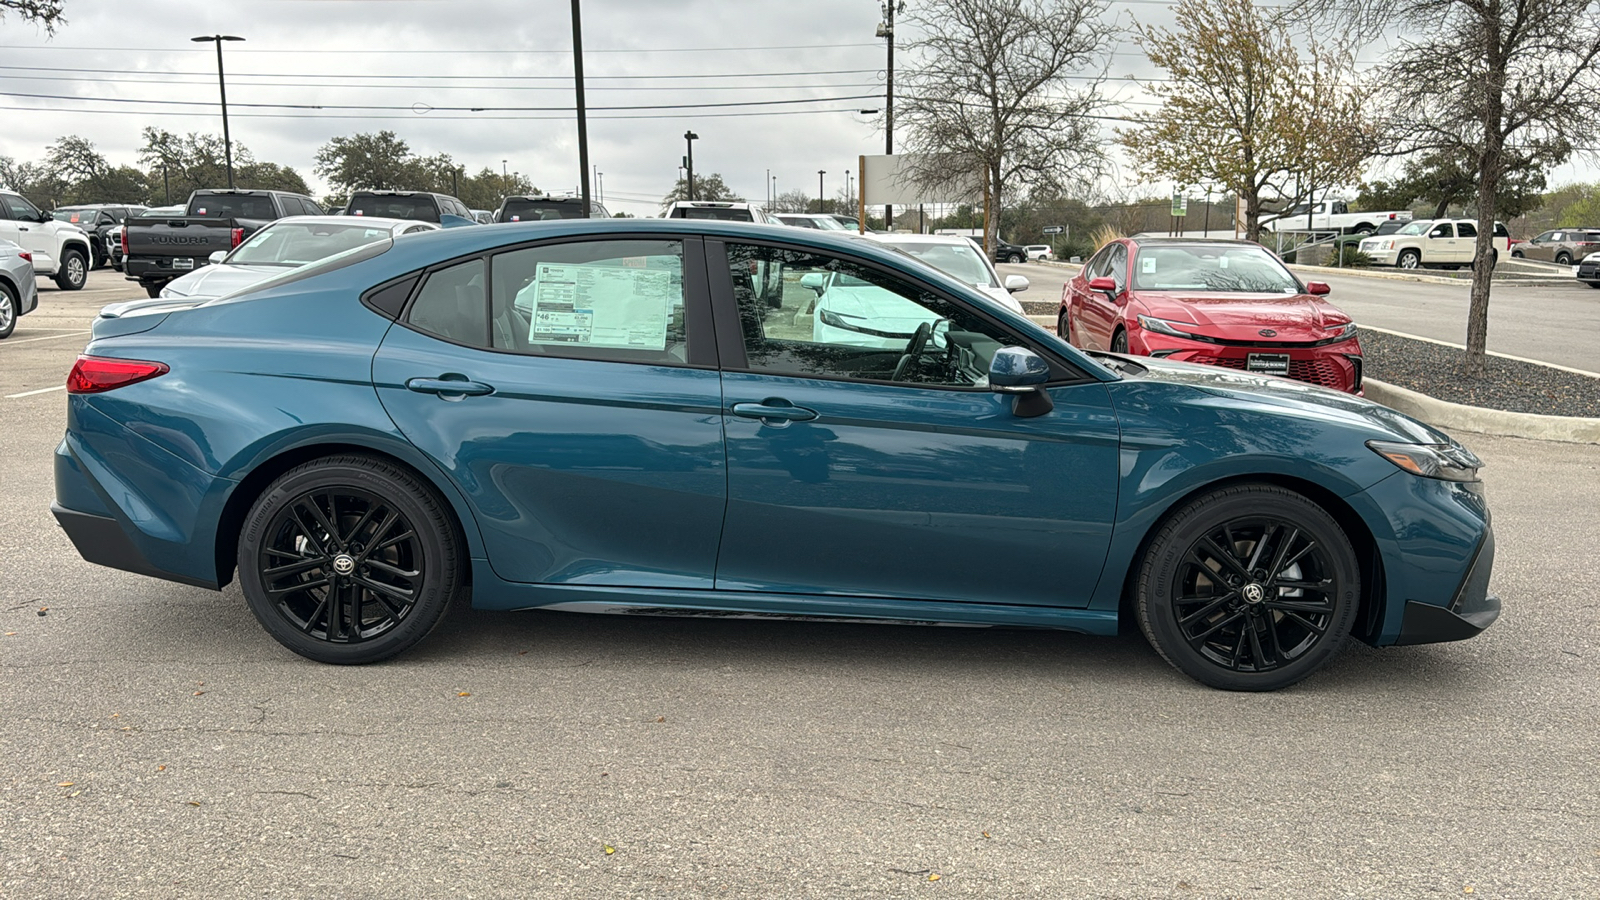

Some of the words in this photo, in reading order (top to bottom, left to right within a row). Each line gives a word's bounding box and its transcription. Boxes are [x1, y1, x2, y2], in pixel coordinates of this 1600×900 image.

[148, 235, 209, 245] TUNDRA
[540, 313, 549, 321] 46
[246, 497, 274, 543] Continental
[1155, 550, 1175, 598] Continental
[408, 587, 438, 631] Continental
